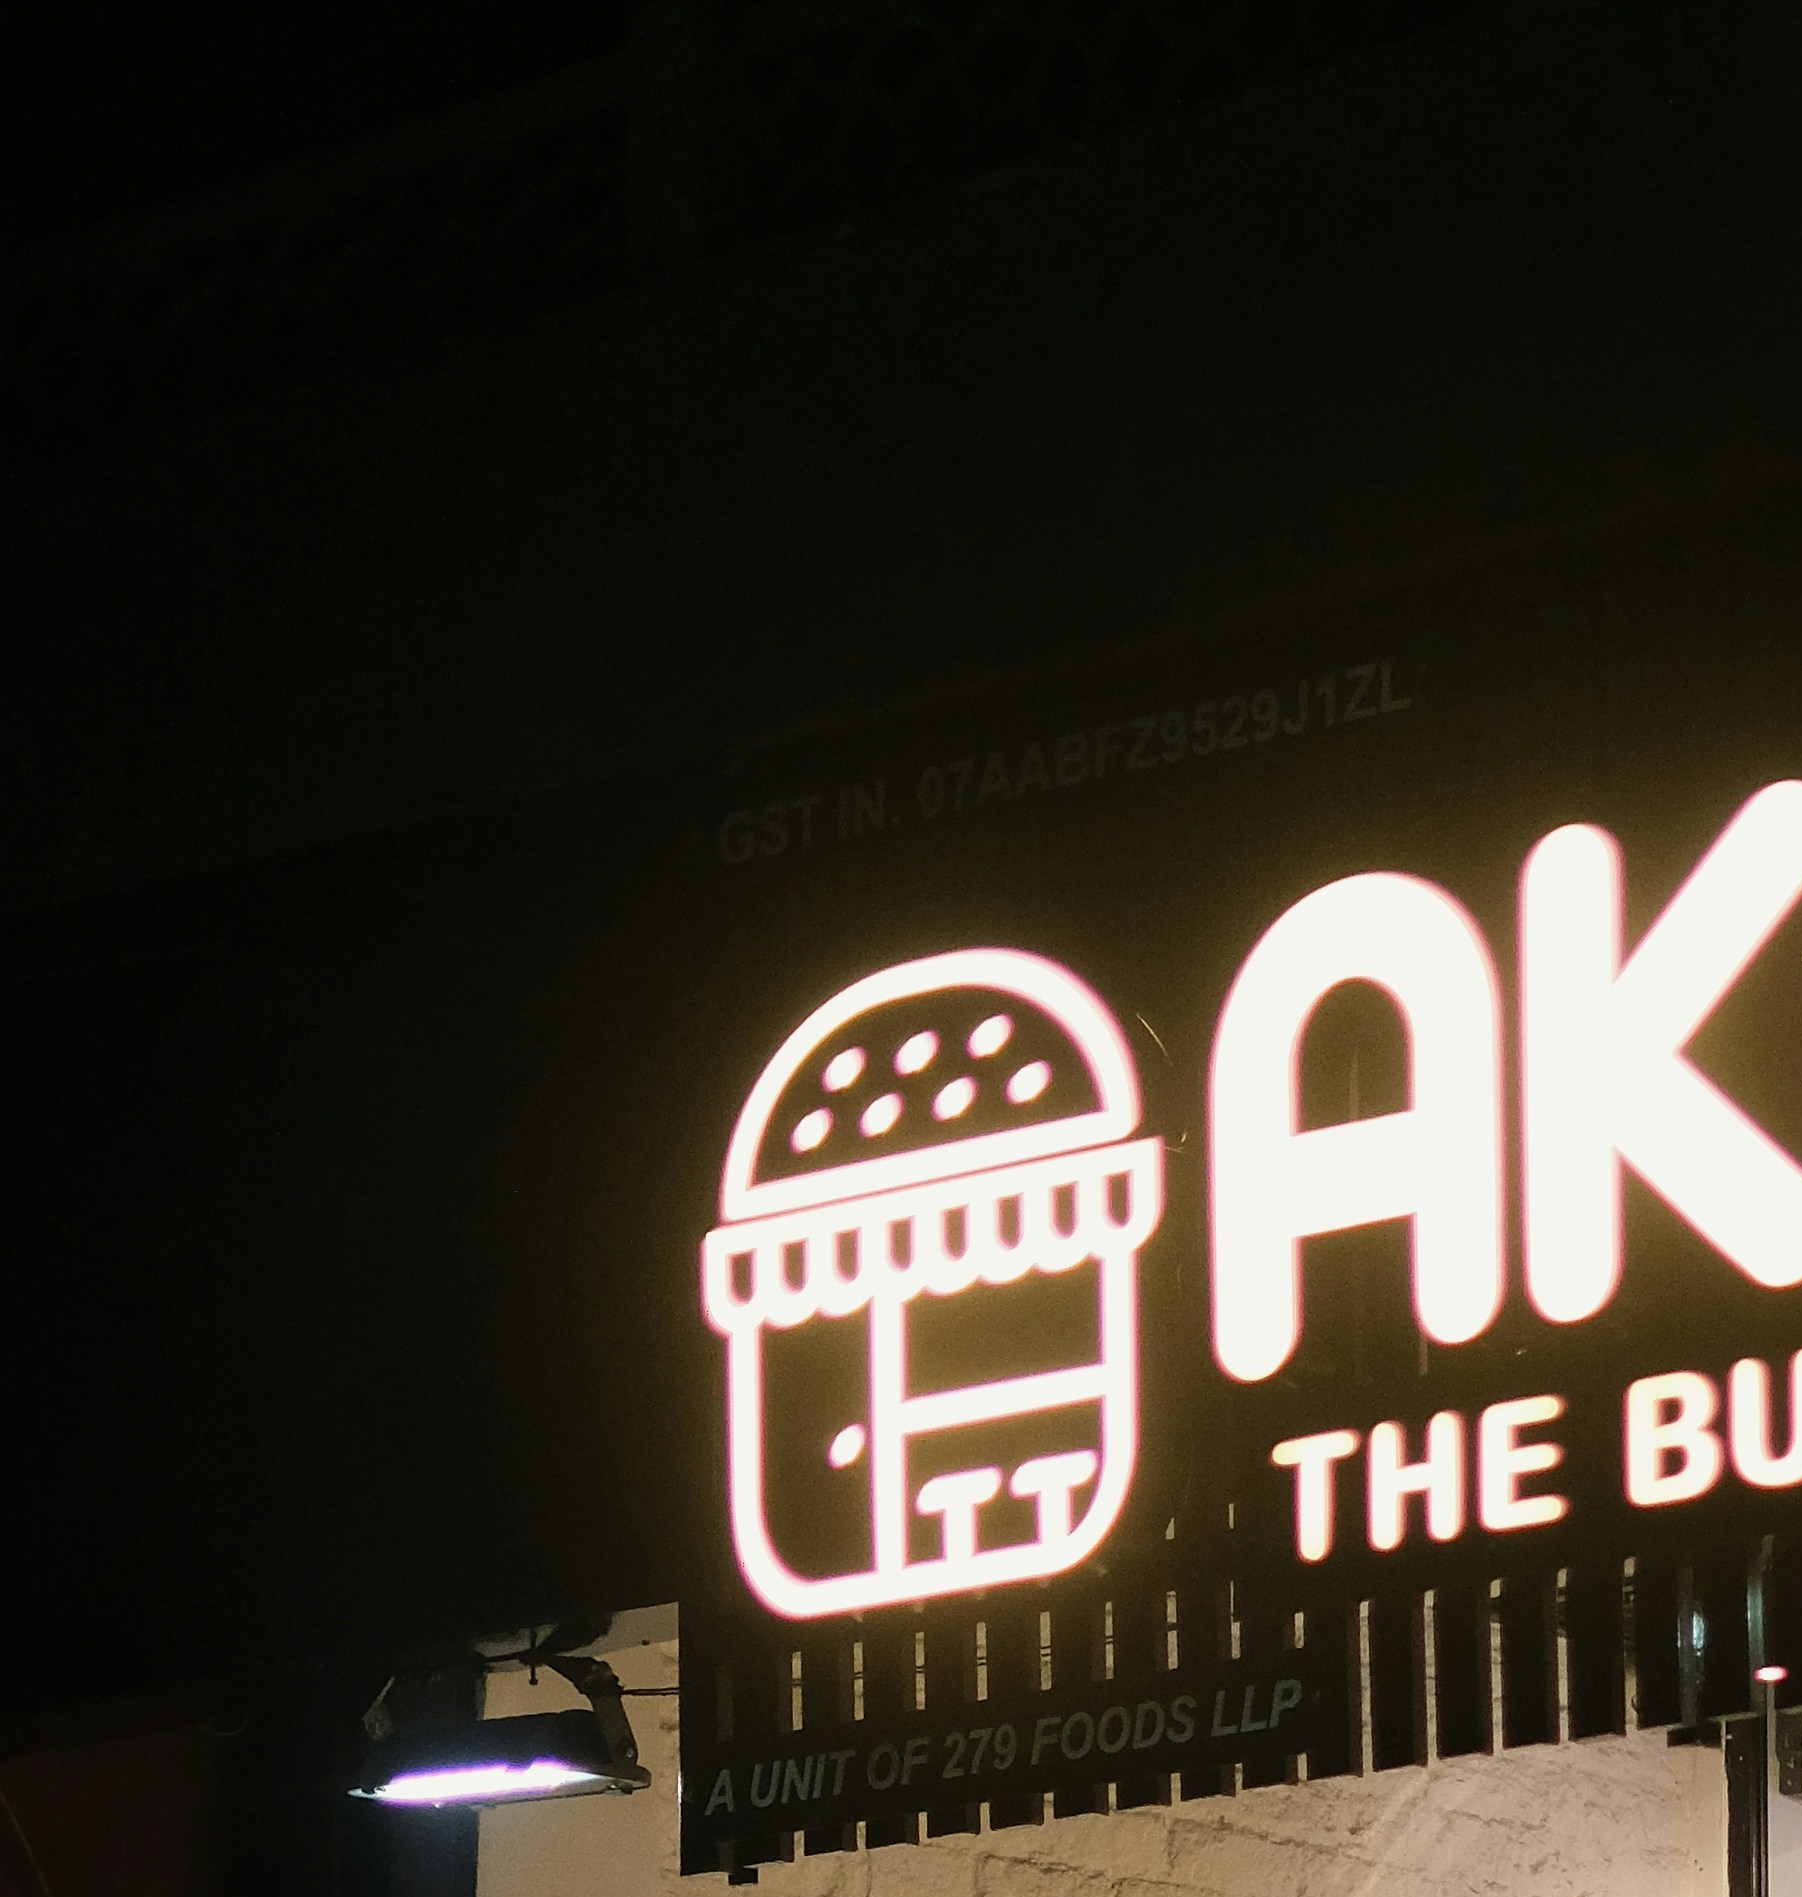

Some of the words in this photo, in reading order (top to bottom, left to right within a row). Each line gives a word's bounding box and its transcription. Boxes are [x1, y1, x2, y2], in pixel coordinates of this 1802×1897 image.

[717, 793, 822, 866] GST
[1274, 1393, 1570, 1565] THE
[704, 1770, 736, 1817] A
[750, 1750, 857, 1810] UNIT
[866, 1737, 930, 1791] OF
[942, 1721, 1018, 1780] 279
[1030, 1695, 1198, 1769] FOODS
[1209, 1678, 1304, 1739] LLP
